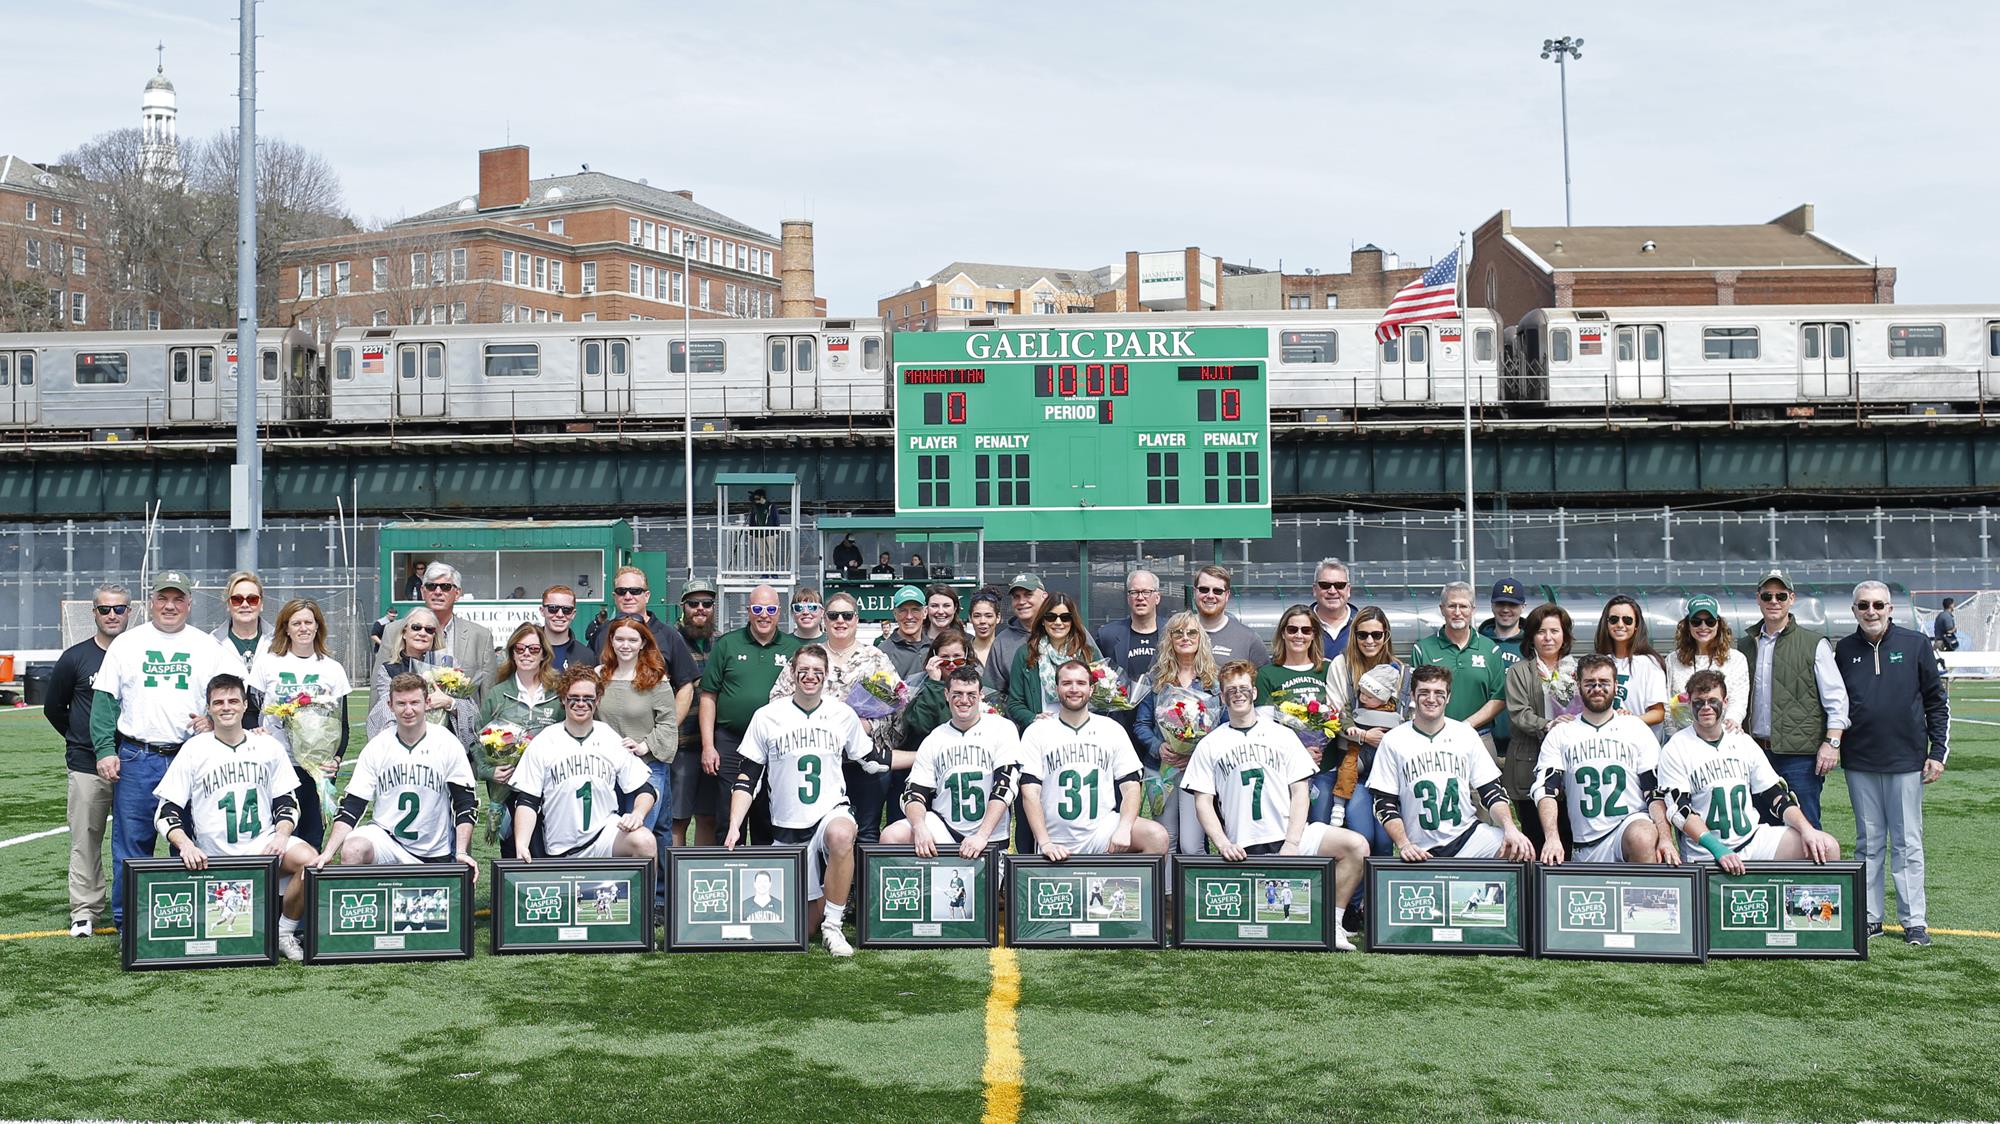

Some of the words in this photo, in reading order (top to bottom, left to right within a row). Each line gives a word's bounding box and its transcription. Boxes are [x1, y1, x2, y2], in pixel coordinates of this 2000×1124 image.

[1580, 327, 1600, 336] 2239
[828, 337, 848, 345] 2237
[966, 333, 1095, 359] GAELIC
[1103, 332, 1196, 358] PARK
[363, 345, 383, 353] 2237
[904, 369, 984, 384] MANHATTAN
[1047, 363, 1129, 395] 10:00
[1200, 366, 1235, 380] NJIT
[949, 392, 966, 423] 0
[1223, 389, 1240, 420] 0
[1045, 405, 1096, 420] PERIOD
[910, 435, 957, 449] PLAYER
[975, 434, 1030, 449] PENALTY
[1138, 433, 1186, 447] PLAYER
[1204, 432, 1259, 446] PENALTY
[1502, 584, 1514, 594] M
[856, 596, 895, 611] AELI
[508, 611, 539, 621] PARK
[145, 664, 189, 674] JASPERS
[1281, 676, 1327, 691] MANHATTAN
[776, 727, 841, 760] MANHATTAN
[1046, 743, 1110, 775] MANHATTAN
[1564, 738, 1634, 770] MANHATTAN
[1218, 743, 1281, 781] MANHATTAN
[1402, 751, 1467, 787] MANHATTAN
[378, 763, 443, 795] MANHATTAN
[550, 754, 612, 789] MANHATTAN
[797, 754, 822, 804] 3
[1690, 758, 1752, 795] MANHATTA
[203, 761, 269, 799] MANHATTAN
[944, 771, 986, 822] 15
[1058, 768, 1098, 820] 31
[1241, 767, 1264, 820] 7
[1575, 765, 1629, 818] 32
[576, 781, 592, 831] 1
[1413, 777, 1462, 830] 34
[218, 788, 262, 843] 14
[394, 791, 420, 840] 2
[1705, 784, 1753, 839] 40
[697, 891, 725, 900] JASPERS
[889, 890, 917, 899] JASPERS
[1042, 894, 1070, 904] JASPERS
[1210, 895, 1238, 904] JASPERS
[529, 899, 559, 908] JASPERS
[1402, 898, 1432, 907] JASPERS
[1573, 904, 1603, 913] JASPERS
[1735, 902, 1765, 911] JASPERS
[158, 906, 190, 916] JASPERS
[344, 907, 375, 916] JASPERS
